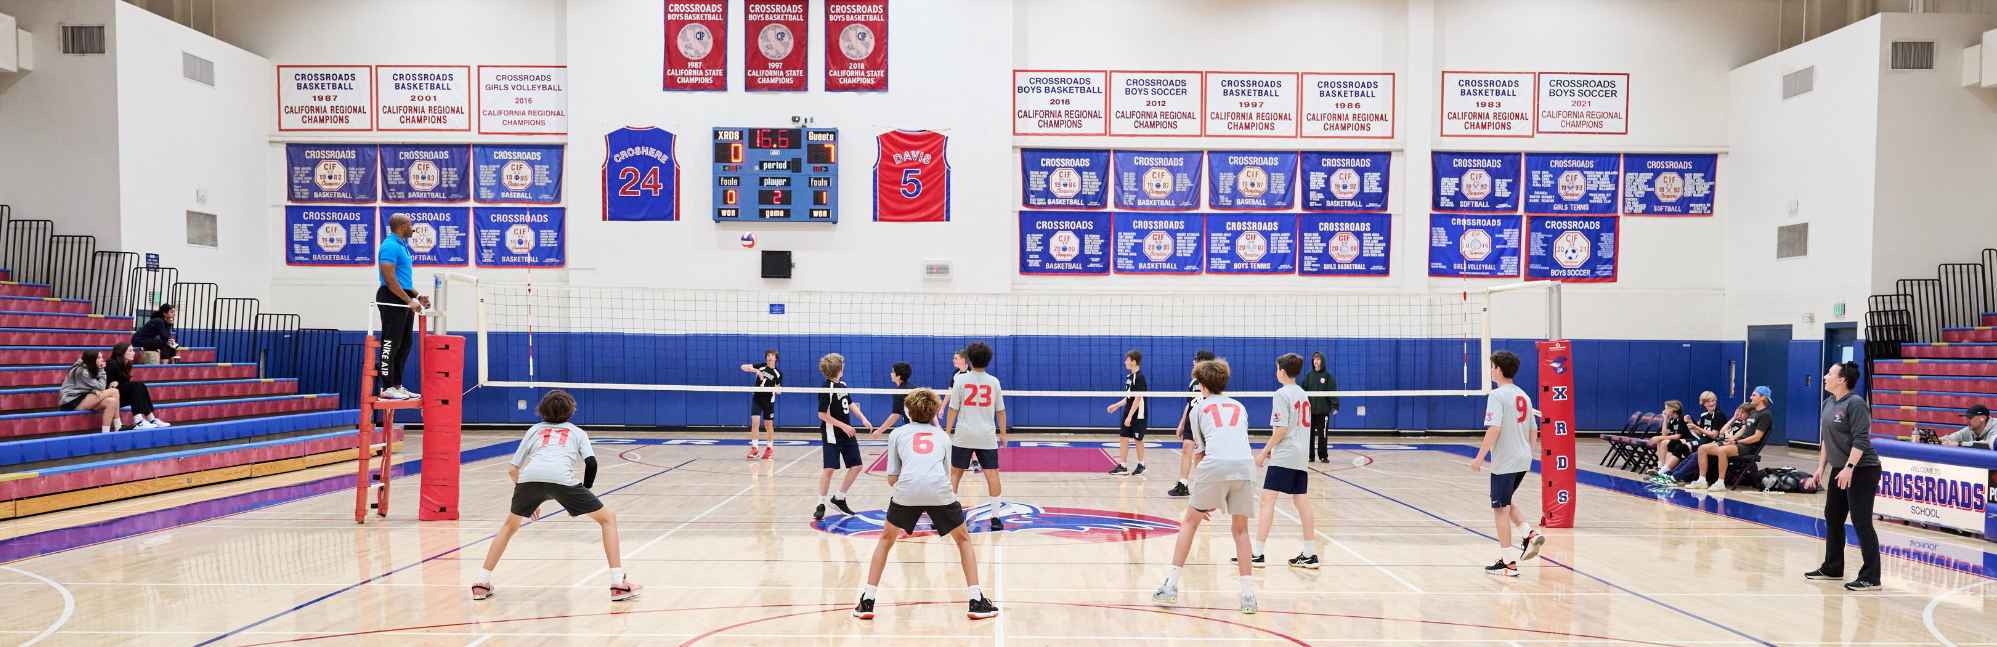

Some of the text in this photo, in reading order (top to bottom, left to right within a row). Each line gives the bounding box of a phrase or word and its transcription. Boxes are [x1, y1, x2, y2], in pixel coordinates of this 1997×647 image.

[668, 4, 722, 13] CROSSROADS
[749, 4, 803, 13] CROSSROADS
[830, 5, 883, 13] CROSSROADS
[394, 82, 451, 90] BASKETBALL
[1126, 79, 1186, 87] CROSSROADS
[1221, 80, 1282, 88] CROSSROADS
[1317, 81, 1378, 89] CROSSROADS
[1549, 80, 1616, 89] CROSSROADS
[511, 84, 563, 92] VOLLEYBALL
[1223, 89, 1279, 97] BASKETBALL
[284, 105, 367, 114] CALIFORNIA REGIONAL
[382, 105, 464, 114] CALIFORNIA REGIONAL
[1017, 110, 1102, 119] CALIFORNIA REGIONAL
[1116, 110, 1196, 120] CALIFORNIA REGIONAL
[1210, 112, 1292, 121] CALIFORNIA REGIONAL
[1306, 113, 1388, 122] CALIFORNIA REGIONAL
[1448, 112, 1529, 120] CALIFORNIA REGIONAL
[1542, 111, 1622, 120] CALIFORNIA REGIONAL
[301, 115, 350, 124] CHAMPIONS
[400, 115, 448, 124] CHAMPIONS
[1038, 119, 1082, 128] CHAMPIONS
[1133, 120, 1178, 129] CHAMPIONS
[1228, 122, 1276, 130] CHAMPIONS
[1323, 123, 1371, 131] CHAMPIONS
[1464, 122, 1512, 130] CHAMPIONS
[808, 132, 834, 141] Guests
[305, 150, 356, 159] CROSSROADS
[399, 151, 449, 160] CROSSROADS
[493, 151, 541, 160] CROSSROADS
[731, 144, 742, 162] 0
[824, 144, 835, 162] 7
[763, 160, 787, 171] period
[1041, 158, 1090, 167] CROSSROADS
[1134, 157, 1184, 166] CROSSROADS
[1228, 156, 1278, 166] CROSSROADS
[1321, 159, 1370, 167] CROSSROADS
[1453, 159, 1502, 168] CROSSROADS
[1550, 160, 1594, 168] CROSSROADS
[1647, 161, 1692, 169] CROSSROADS
[619, 166, 663, 196] 24
[764, 177, 786, 187] player
[810, 178, 828, 186] fouls
[901, 168, 922, 199] 5
[727, 190, 736, 204] 0
[773, 190, 782, 204] 2
[822, 191, 827, 204] 1
[303, 211, 360, 220] CROSSROADS
[490, 214, 549, 222] CROSSROADS
[765, 209, 784, 218] game
[1036, 221, 1093, 230] CROSSROADS
[1133, 220, 1184, 229] CROSSROADS
[1226, 222, 1278, 231] CROSSROADS
[1451, 218, 1501, 226] CROSSROADS
[1545, 221, 1600, 229] CROSSROADS
[1319, 222, 1370, 232] CROSSROADS
[380, 340, 392, 376] NIKE AIR
[963, 384, 992, 407] 23
[842, 398, 850, 414] 9
[1515, 396, 1528, 423] 9
[1203, 403, 1242, 428] 17
[1294, 400, 1311, 428] 10
[538, 428, 570, 448] 11
[912, 432, 934, 454] 6
[1910, 506, 1940, 518] SCHOOL
